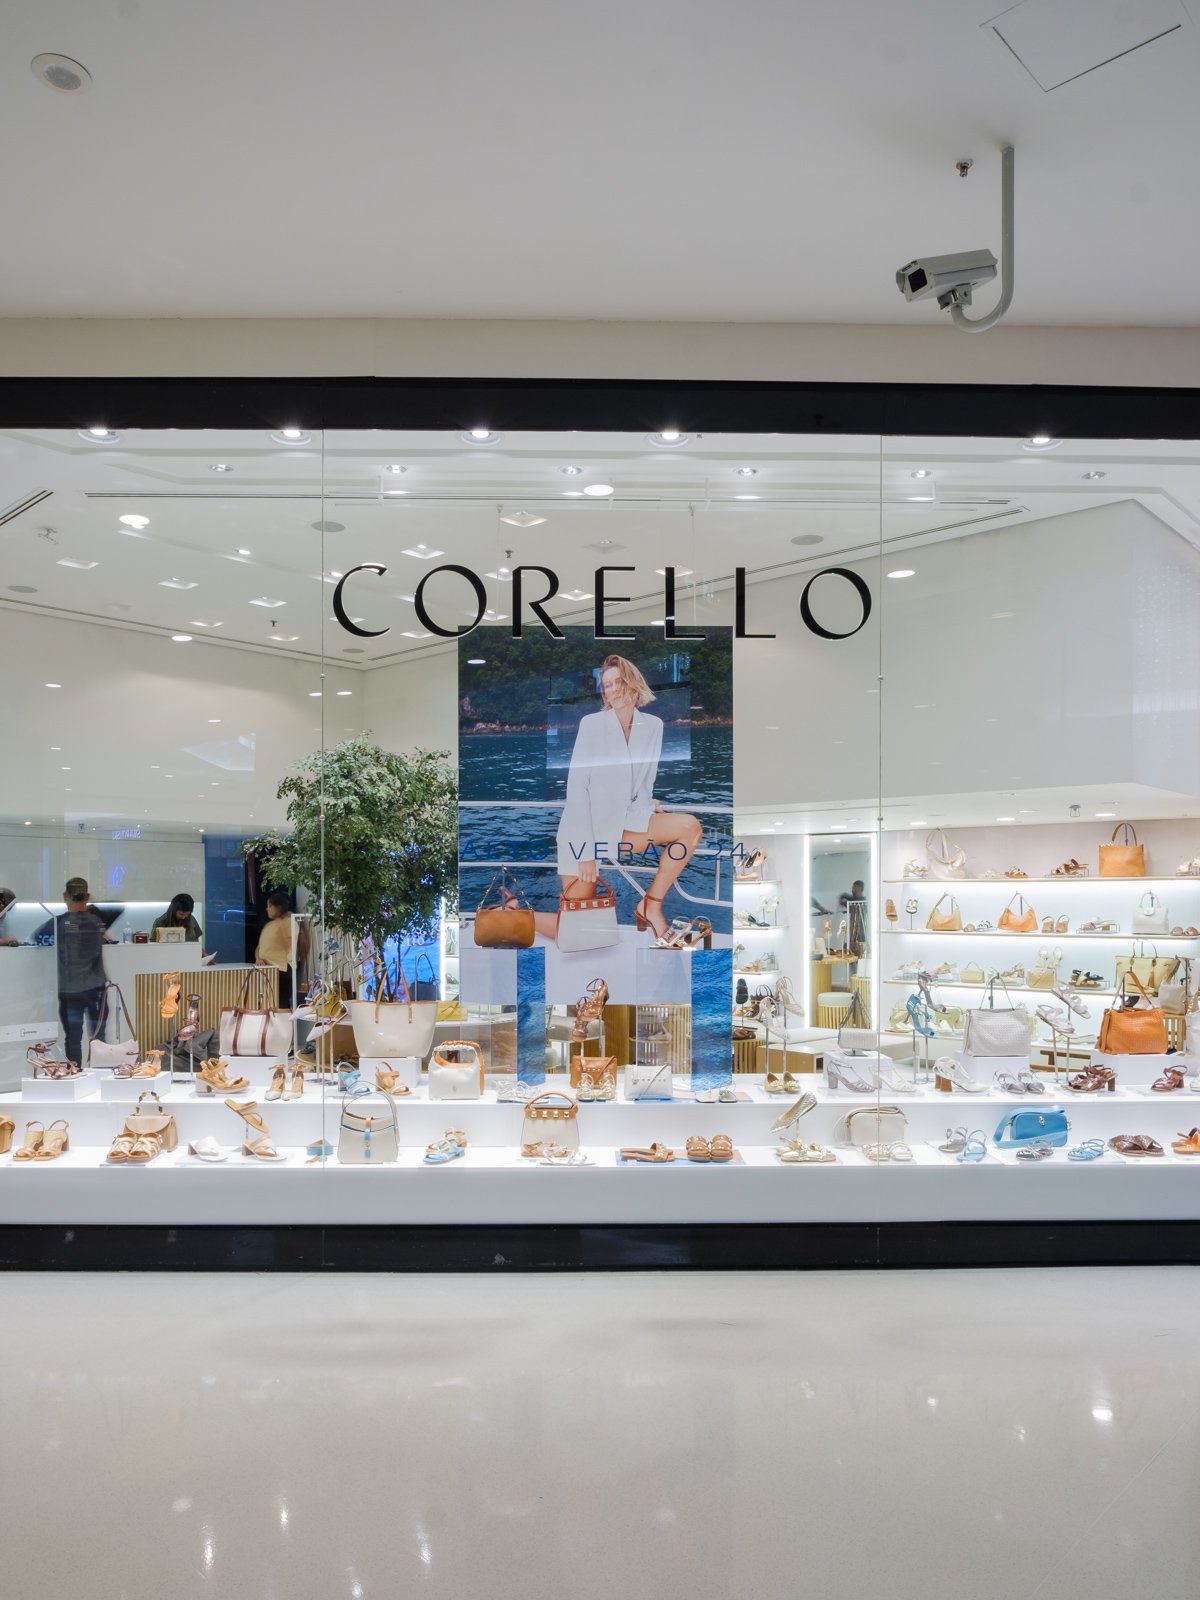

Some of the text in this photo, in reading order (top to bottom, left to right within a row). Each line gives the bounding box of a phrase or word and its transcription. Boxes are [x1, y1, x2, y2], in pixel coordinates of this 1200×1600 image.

[333, 564, 872, 640] CORELLO
[459, 839, 747, 861] ALTO VERÃO 24
